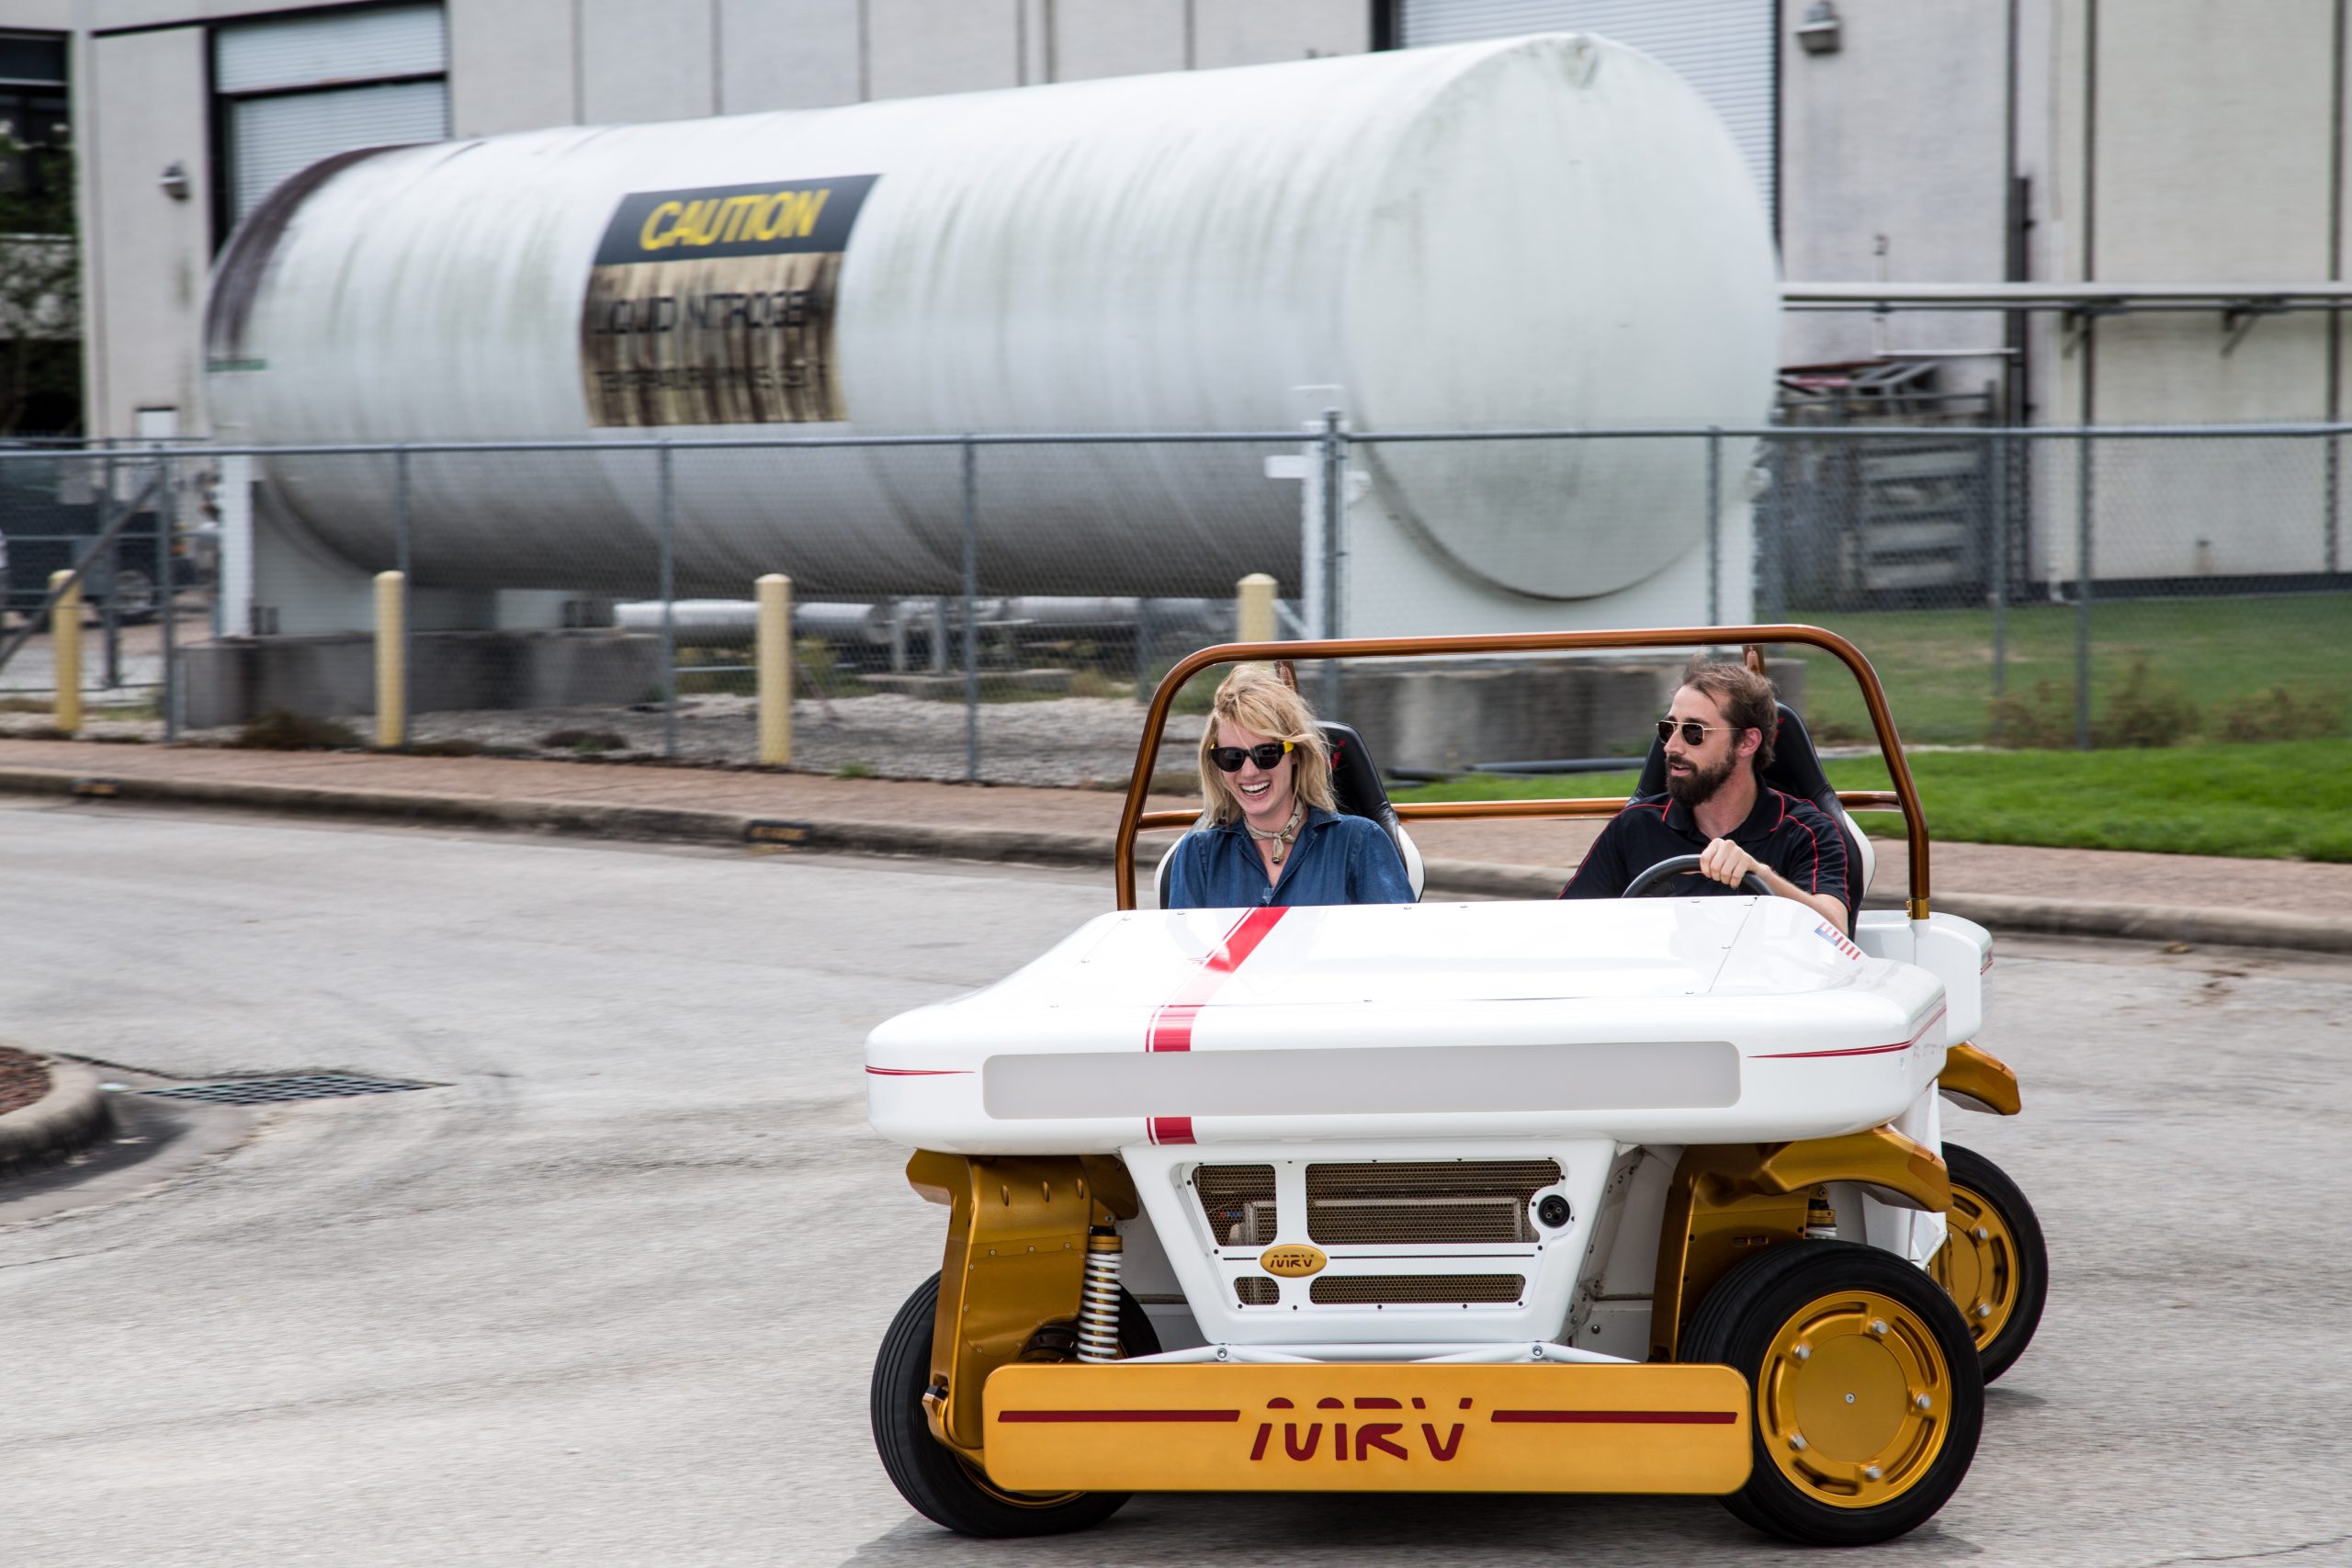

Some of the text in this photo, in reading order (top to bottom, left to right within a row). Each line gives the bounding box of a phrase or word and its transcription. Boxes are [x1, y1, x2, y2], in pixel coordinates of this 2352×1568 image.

[640, 189, 831, 251] CAUTION
[1270, 1254, 1315, 1268] MRV
[1250, 1396, 1473, 1461] MRV
